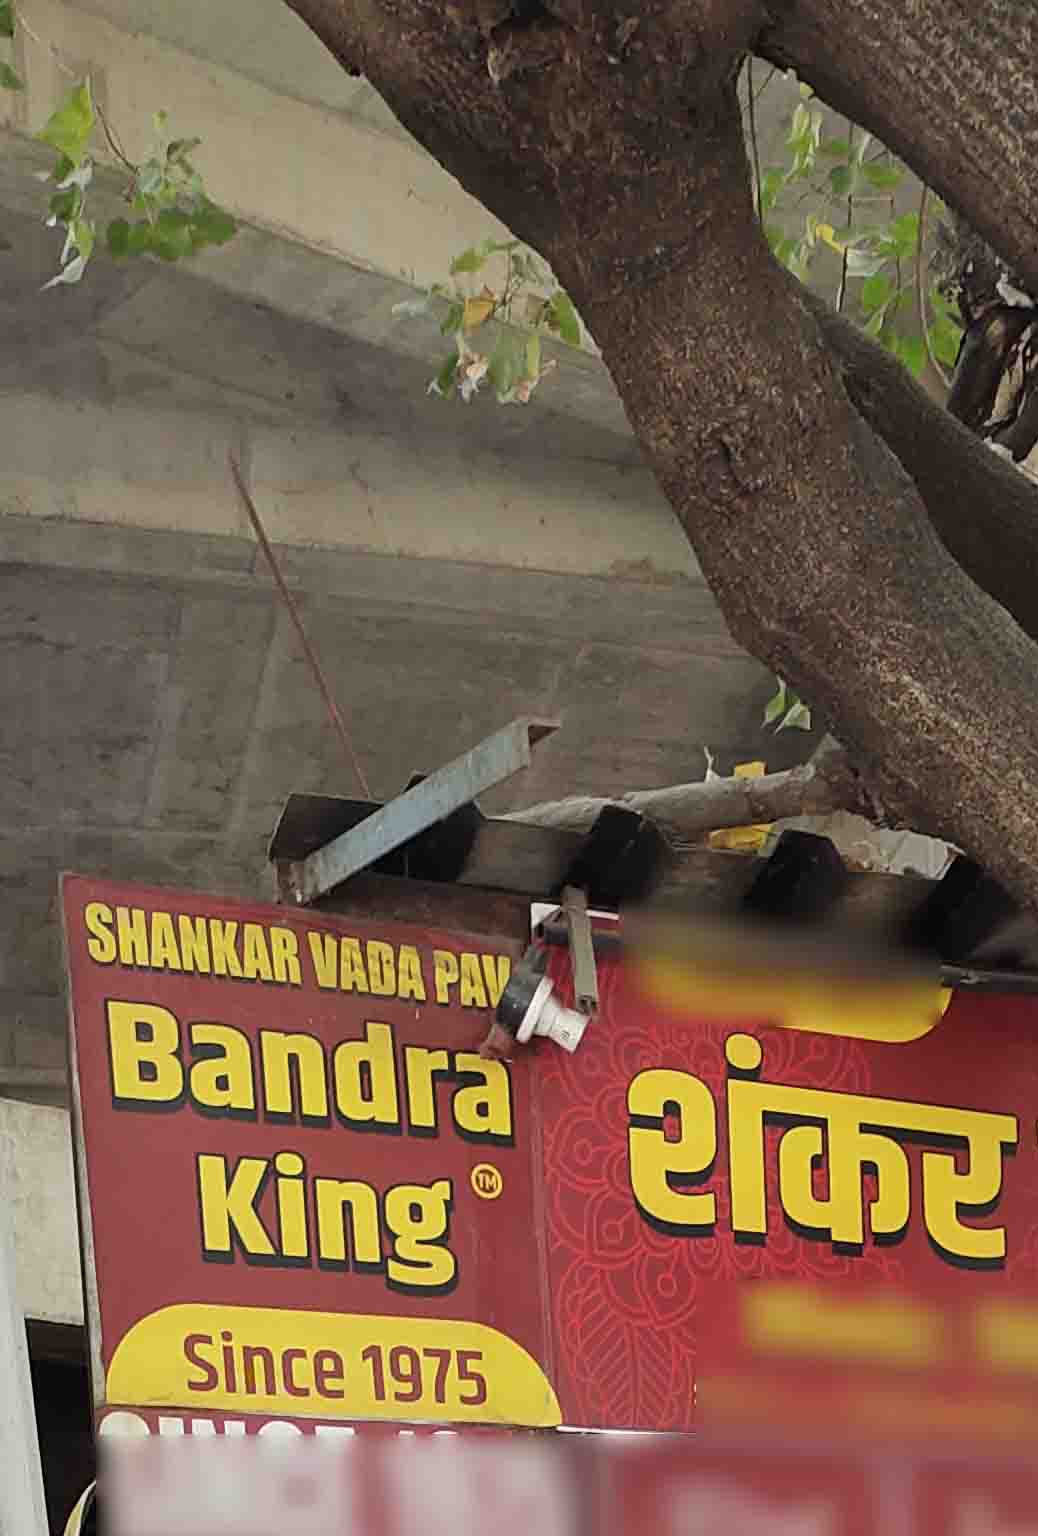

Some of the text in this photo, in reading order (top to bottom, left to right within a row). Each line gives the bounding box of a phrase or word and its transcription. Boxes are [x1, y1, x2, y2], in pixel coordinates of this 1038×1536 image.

[84, 901, 512, 1009] SHANKAR VADA PAV
[105, 999, 515, 1142] Bandra
[627, 1031, 1020, 1264] शंकर
[196, 1152, 457, 1289] King
[183, 1331, 488, 1406] Since 1975
